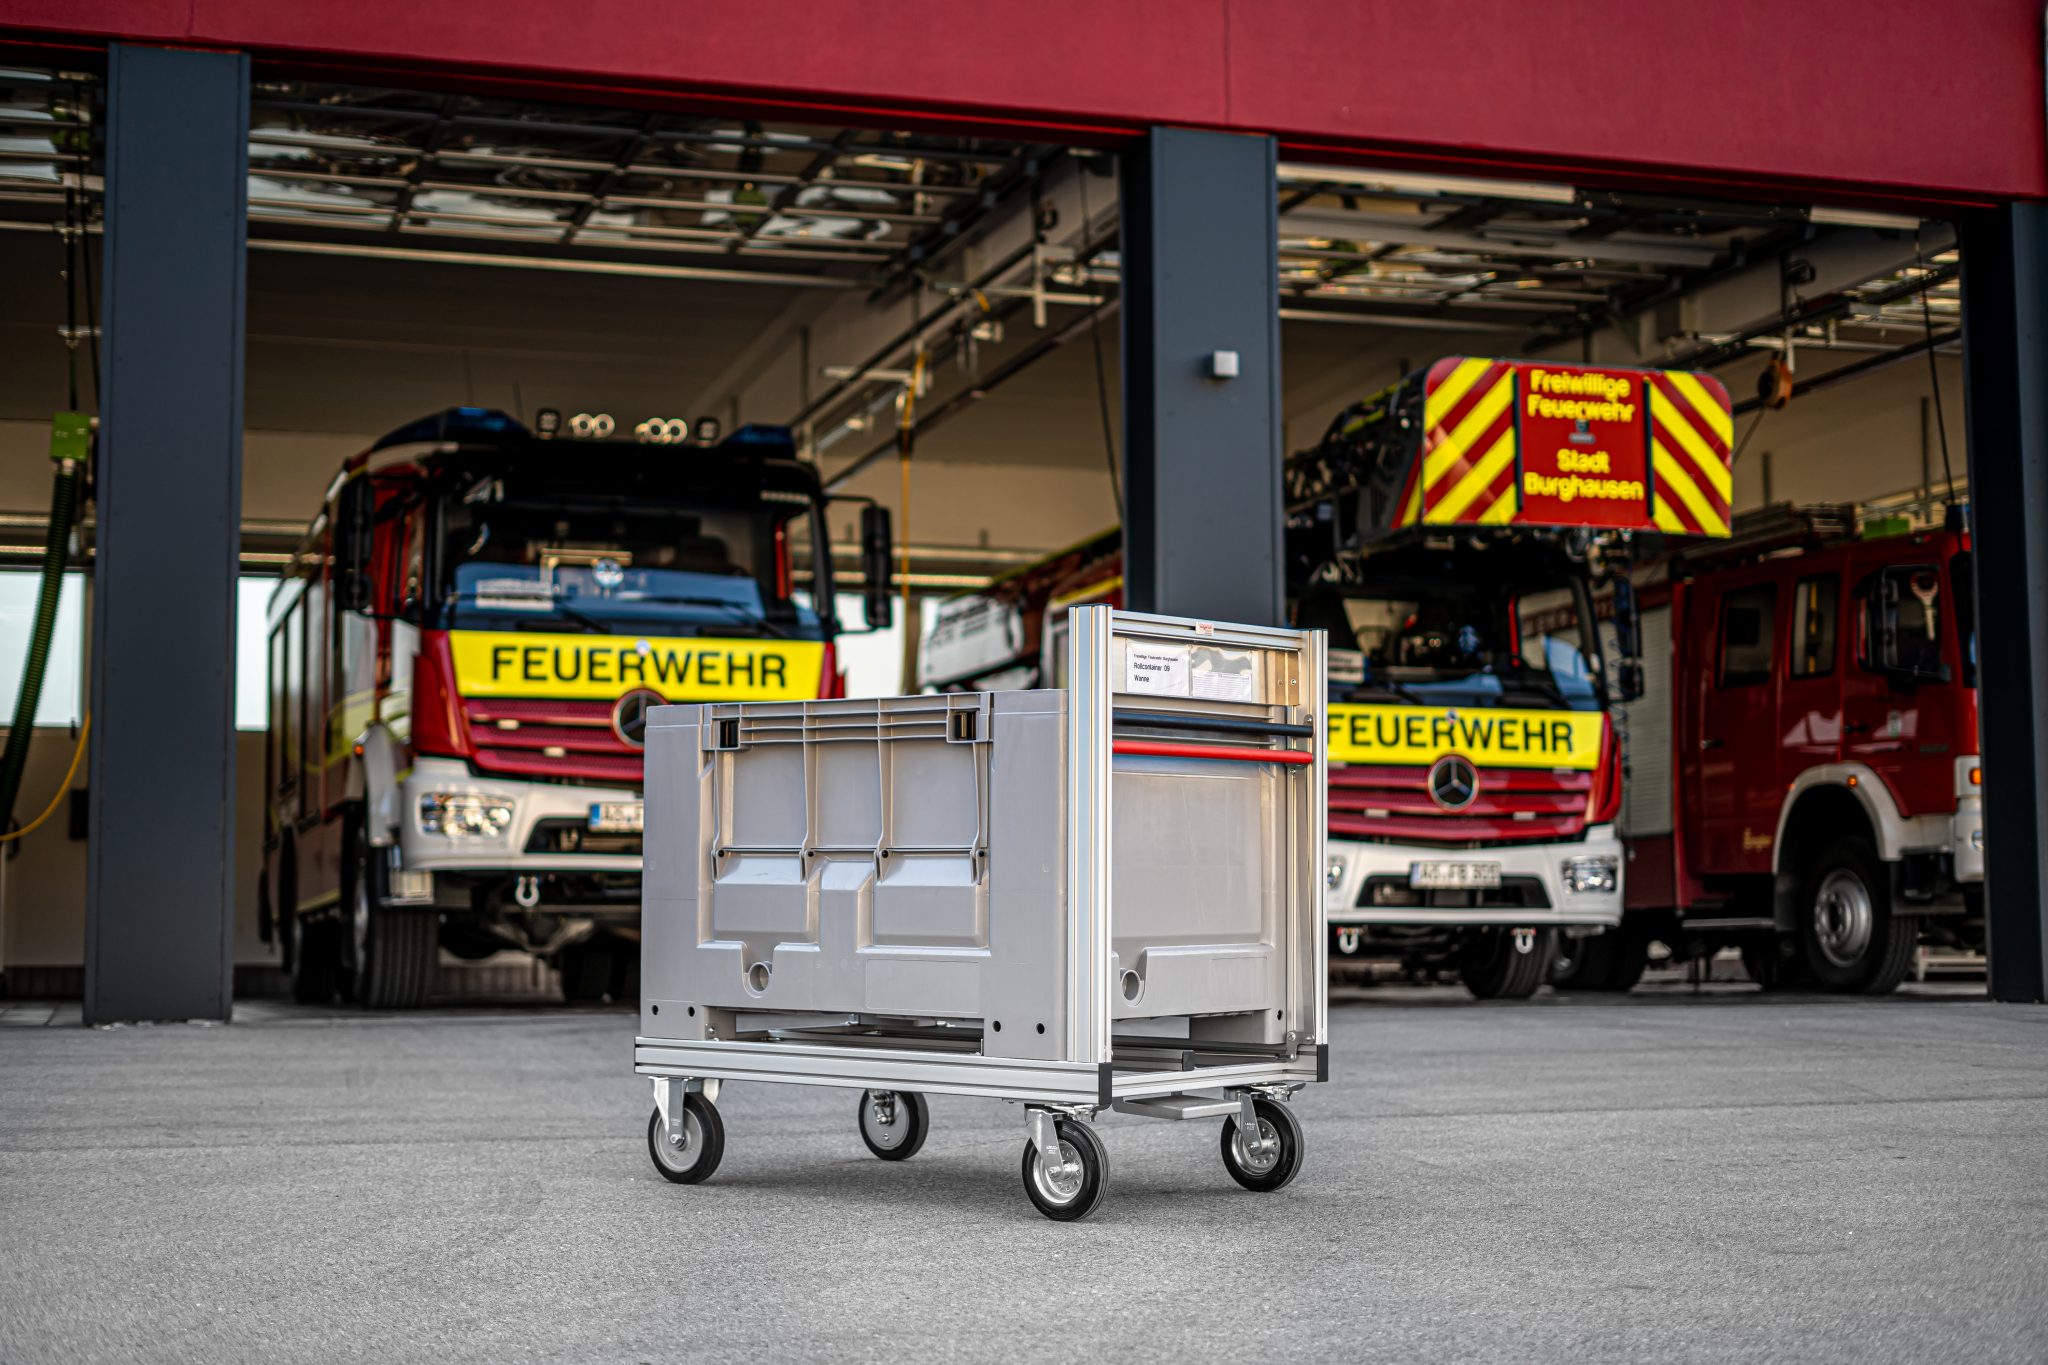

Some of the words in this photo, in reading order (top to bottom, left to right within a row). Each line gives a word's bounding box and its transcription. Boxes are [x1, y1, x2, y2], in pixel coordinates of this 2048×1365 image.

[1530, 369, 1631, 401] Freiwillige
[1527, 394, 1635, 422] Feuerwehr
[1557, 449, 1610, 474] Stadt
[1524, 472, 1644, 502] Burghausen
[492, 645, 787, 688] FEUERWEHR
[1134, 662, 1162, 671] Rollcontainer
[1134, 674, 1150, 682] Wanne
[1327, 713, 1573, 752] FEUERWEHR
